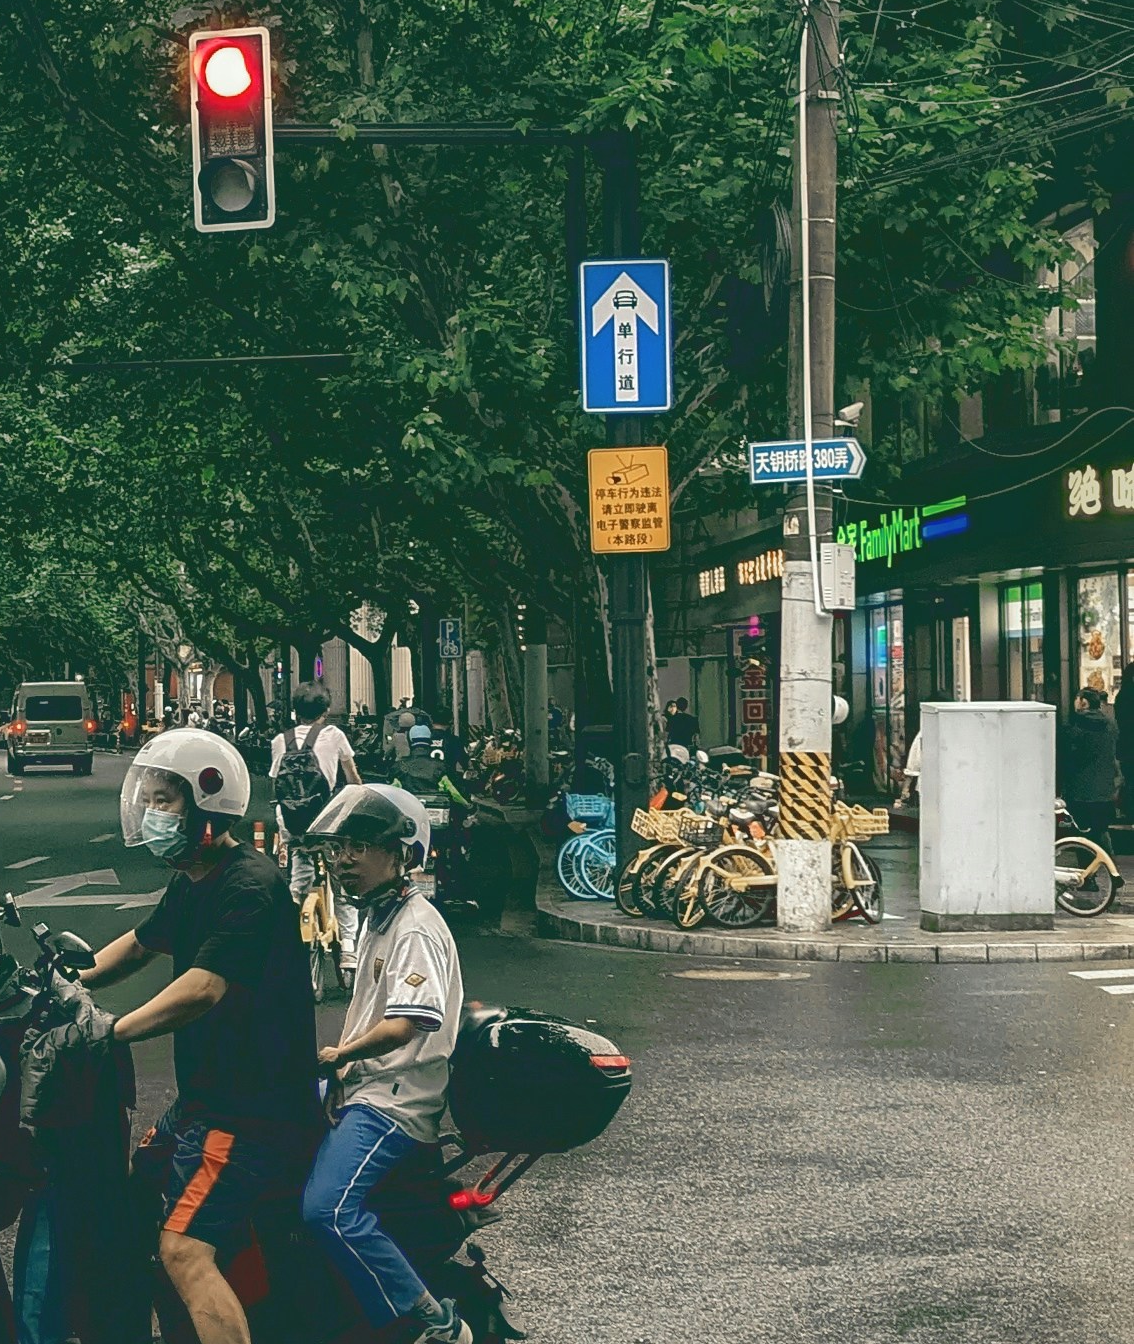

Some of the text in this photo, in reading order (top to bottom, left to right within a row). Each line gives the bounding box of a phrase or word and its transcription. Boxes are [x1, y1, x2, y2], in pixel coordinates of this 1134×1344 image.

[617, 322, 635, 391] 单行道
[595, 486, 662, 501] 停车行为违法
[601, 502, 658, 516] 请立即驶离
[596, 517, 664, 532] 电子警察监管
[859, 506, 923, 568] FamilyMart
[446, 621, 454, 639] P
